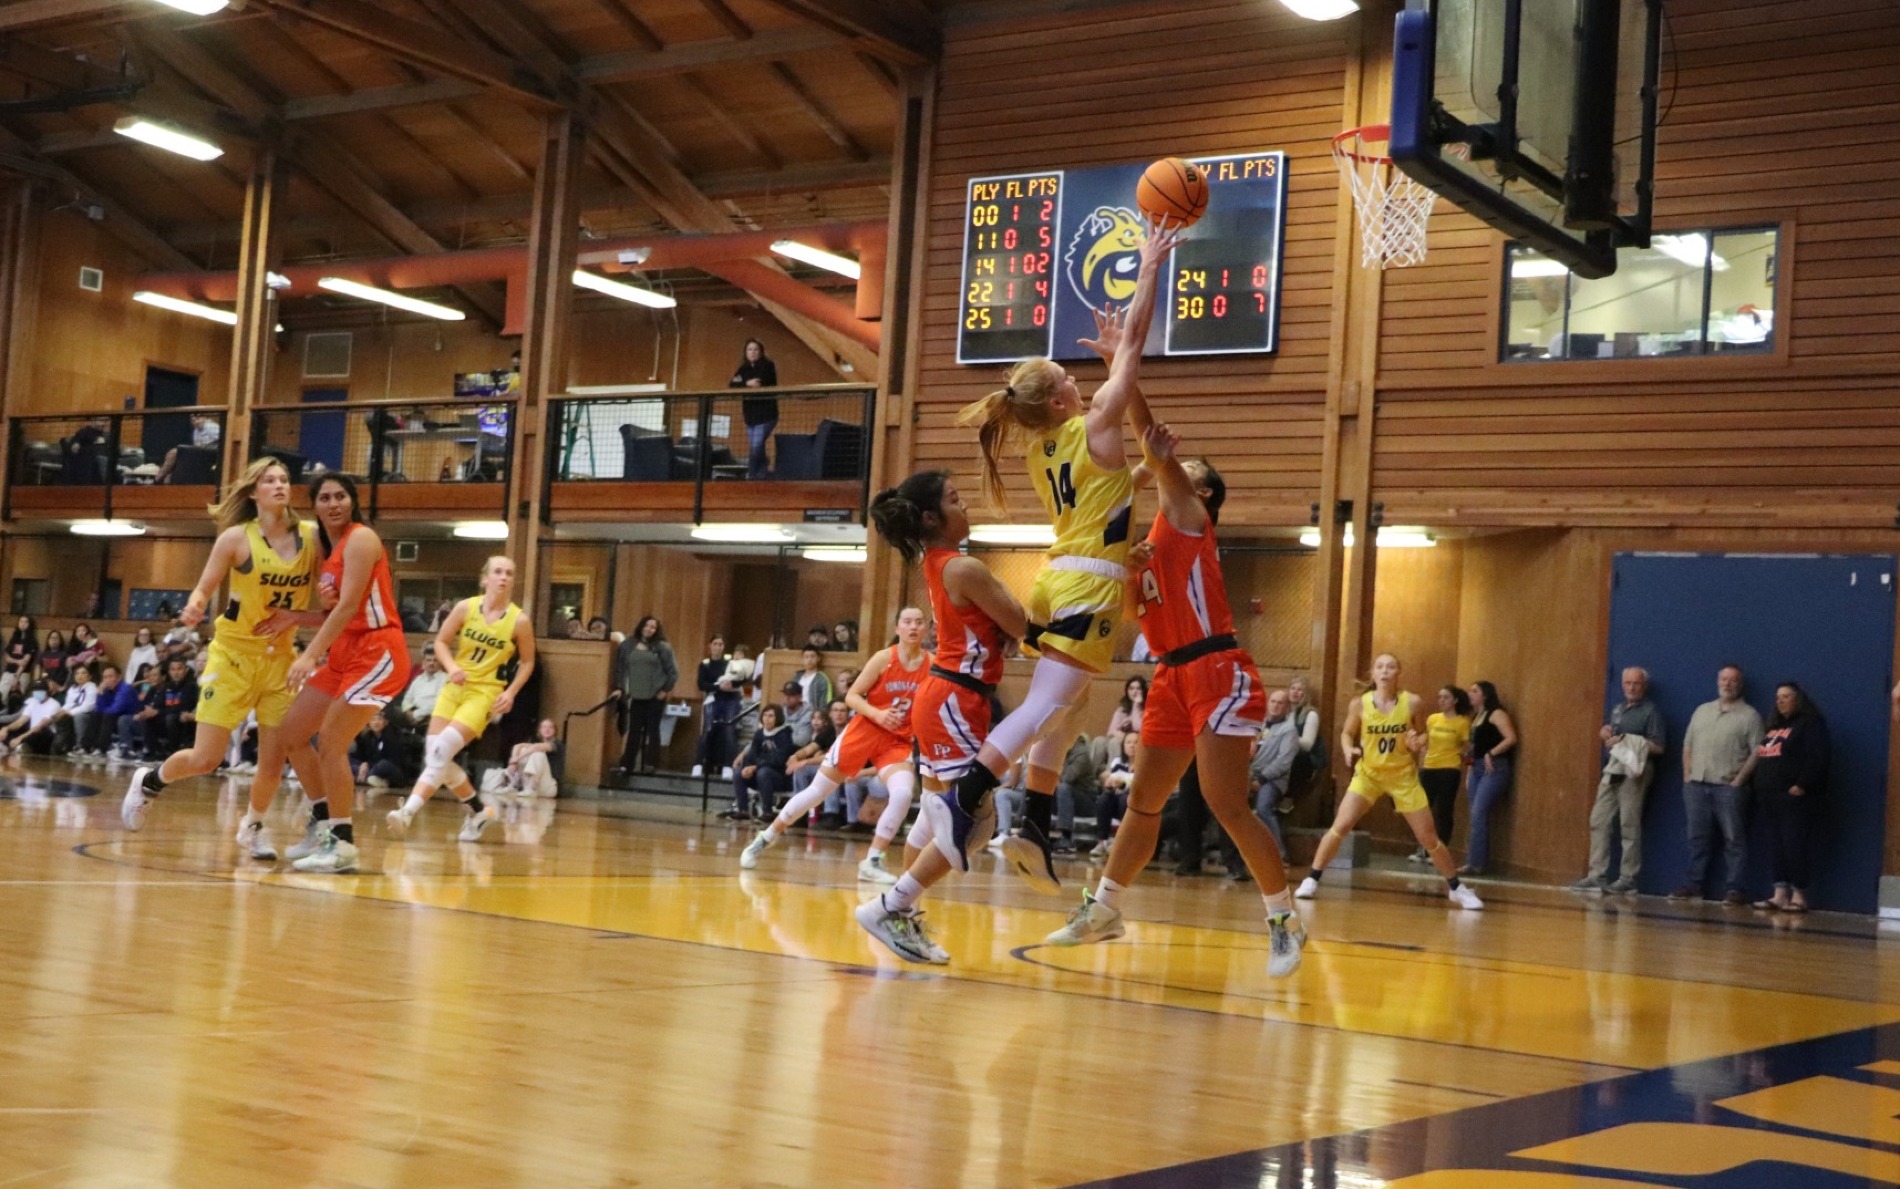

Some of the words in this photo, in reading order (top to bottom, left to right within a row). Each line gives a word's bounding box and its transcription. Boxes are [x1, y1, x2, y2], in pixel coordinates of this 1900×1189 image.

[1219, 162, 1239, 181] FL
[1244, 158, 1276, 179] PTS
[972, 183, 1000, 202] PLY
[1006, 181, 1024, 199] FL
[1028, 178, 1057, 197] PTS
[972, 204, 1000, 227] 00
[1012, 205, 1019, 222] 1
[1040, 199, 1054, 222] 2
[978, 231, 997, 250] 11
[1004, 228, 1017, 250] 0
[1039, 226, 1052, 248] 5
[976, 258, 995, 276] 14
[1177, 269, 1206, 292] 24
[1222, 269, 1229, 288] 1
[1252, 265, 1267, 289] 0
[967, 281, 994, 304] 22
[1007, 282, 1014, 300] 1
[1035, 281, 1048, 298] 4
[966, 307, 992, 330] 25
[1006, 308, 1013, 326] 1
[1033, 304, 1047, 327] 0
[1177, 296, 1205, 319] 30
[1212, 294, 1228, 318] 0
[1252, 292, 1266, 314] 7
[1045, 462, 1077, 516] 14
[259, 571, 311, 587] SLUGS
[268, 591, 296, 611] 25
[463, 628, 507, 650] SLUGS
[470, 646, 488, 664] 11
[1366, 723, 1408, 735] SLUGS
[1378, 737, 1397, 754] 00
